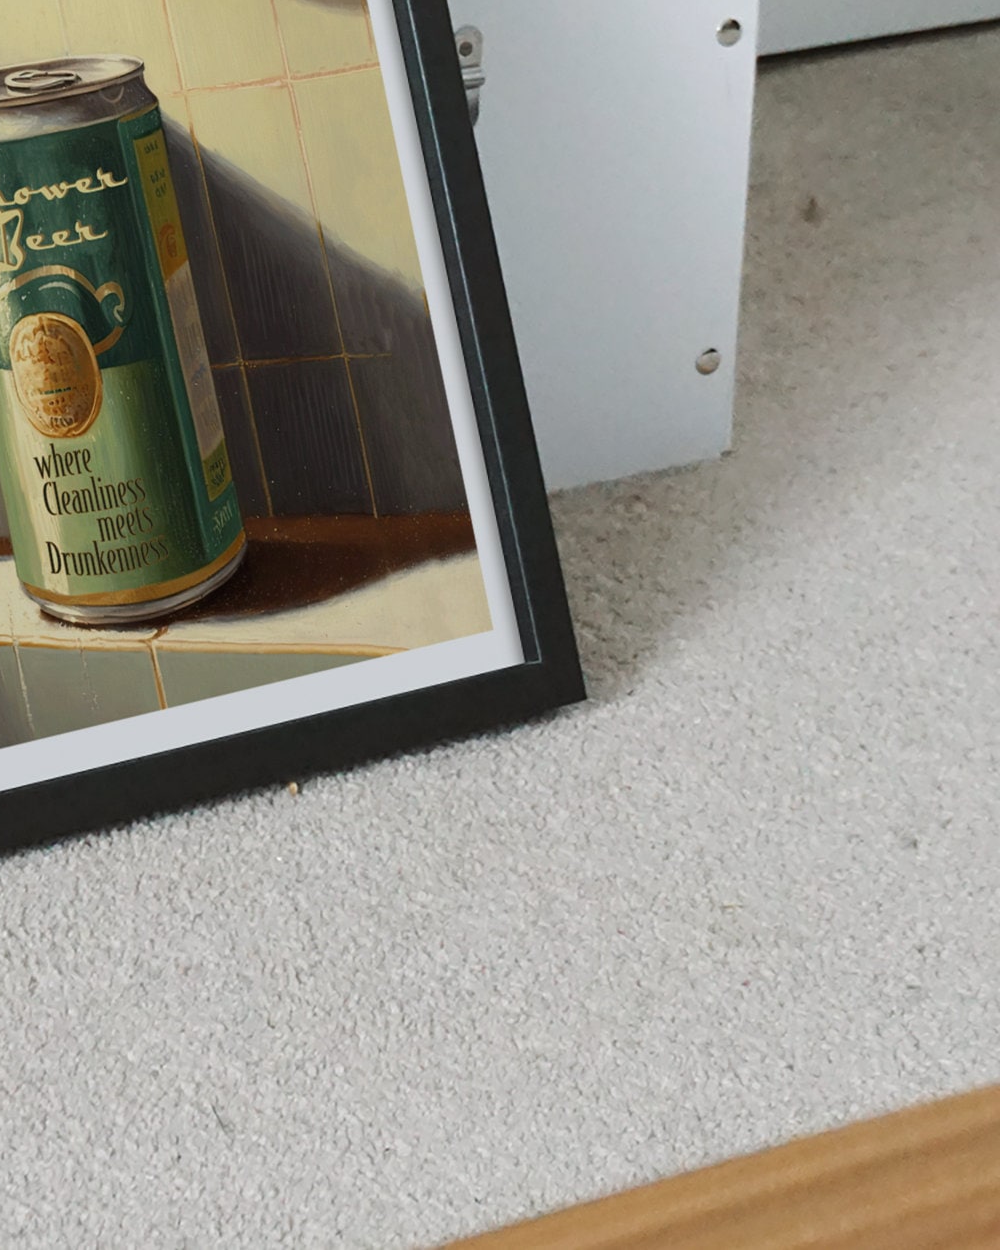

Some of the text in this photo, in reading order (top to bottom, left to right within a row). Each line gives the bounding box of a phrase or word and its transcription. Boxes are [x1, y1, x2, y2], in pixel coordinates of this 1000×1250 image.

[33, 442, 92, 479] where
[42, 477, 146, 516] Cleanliness
[96, 507, 153, 543] meets
[45, 535, 169, 576] Drunkenness
